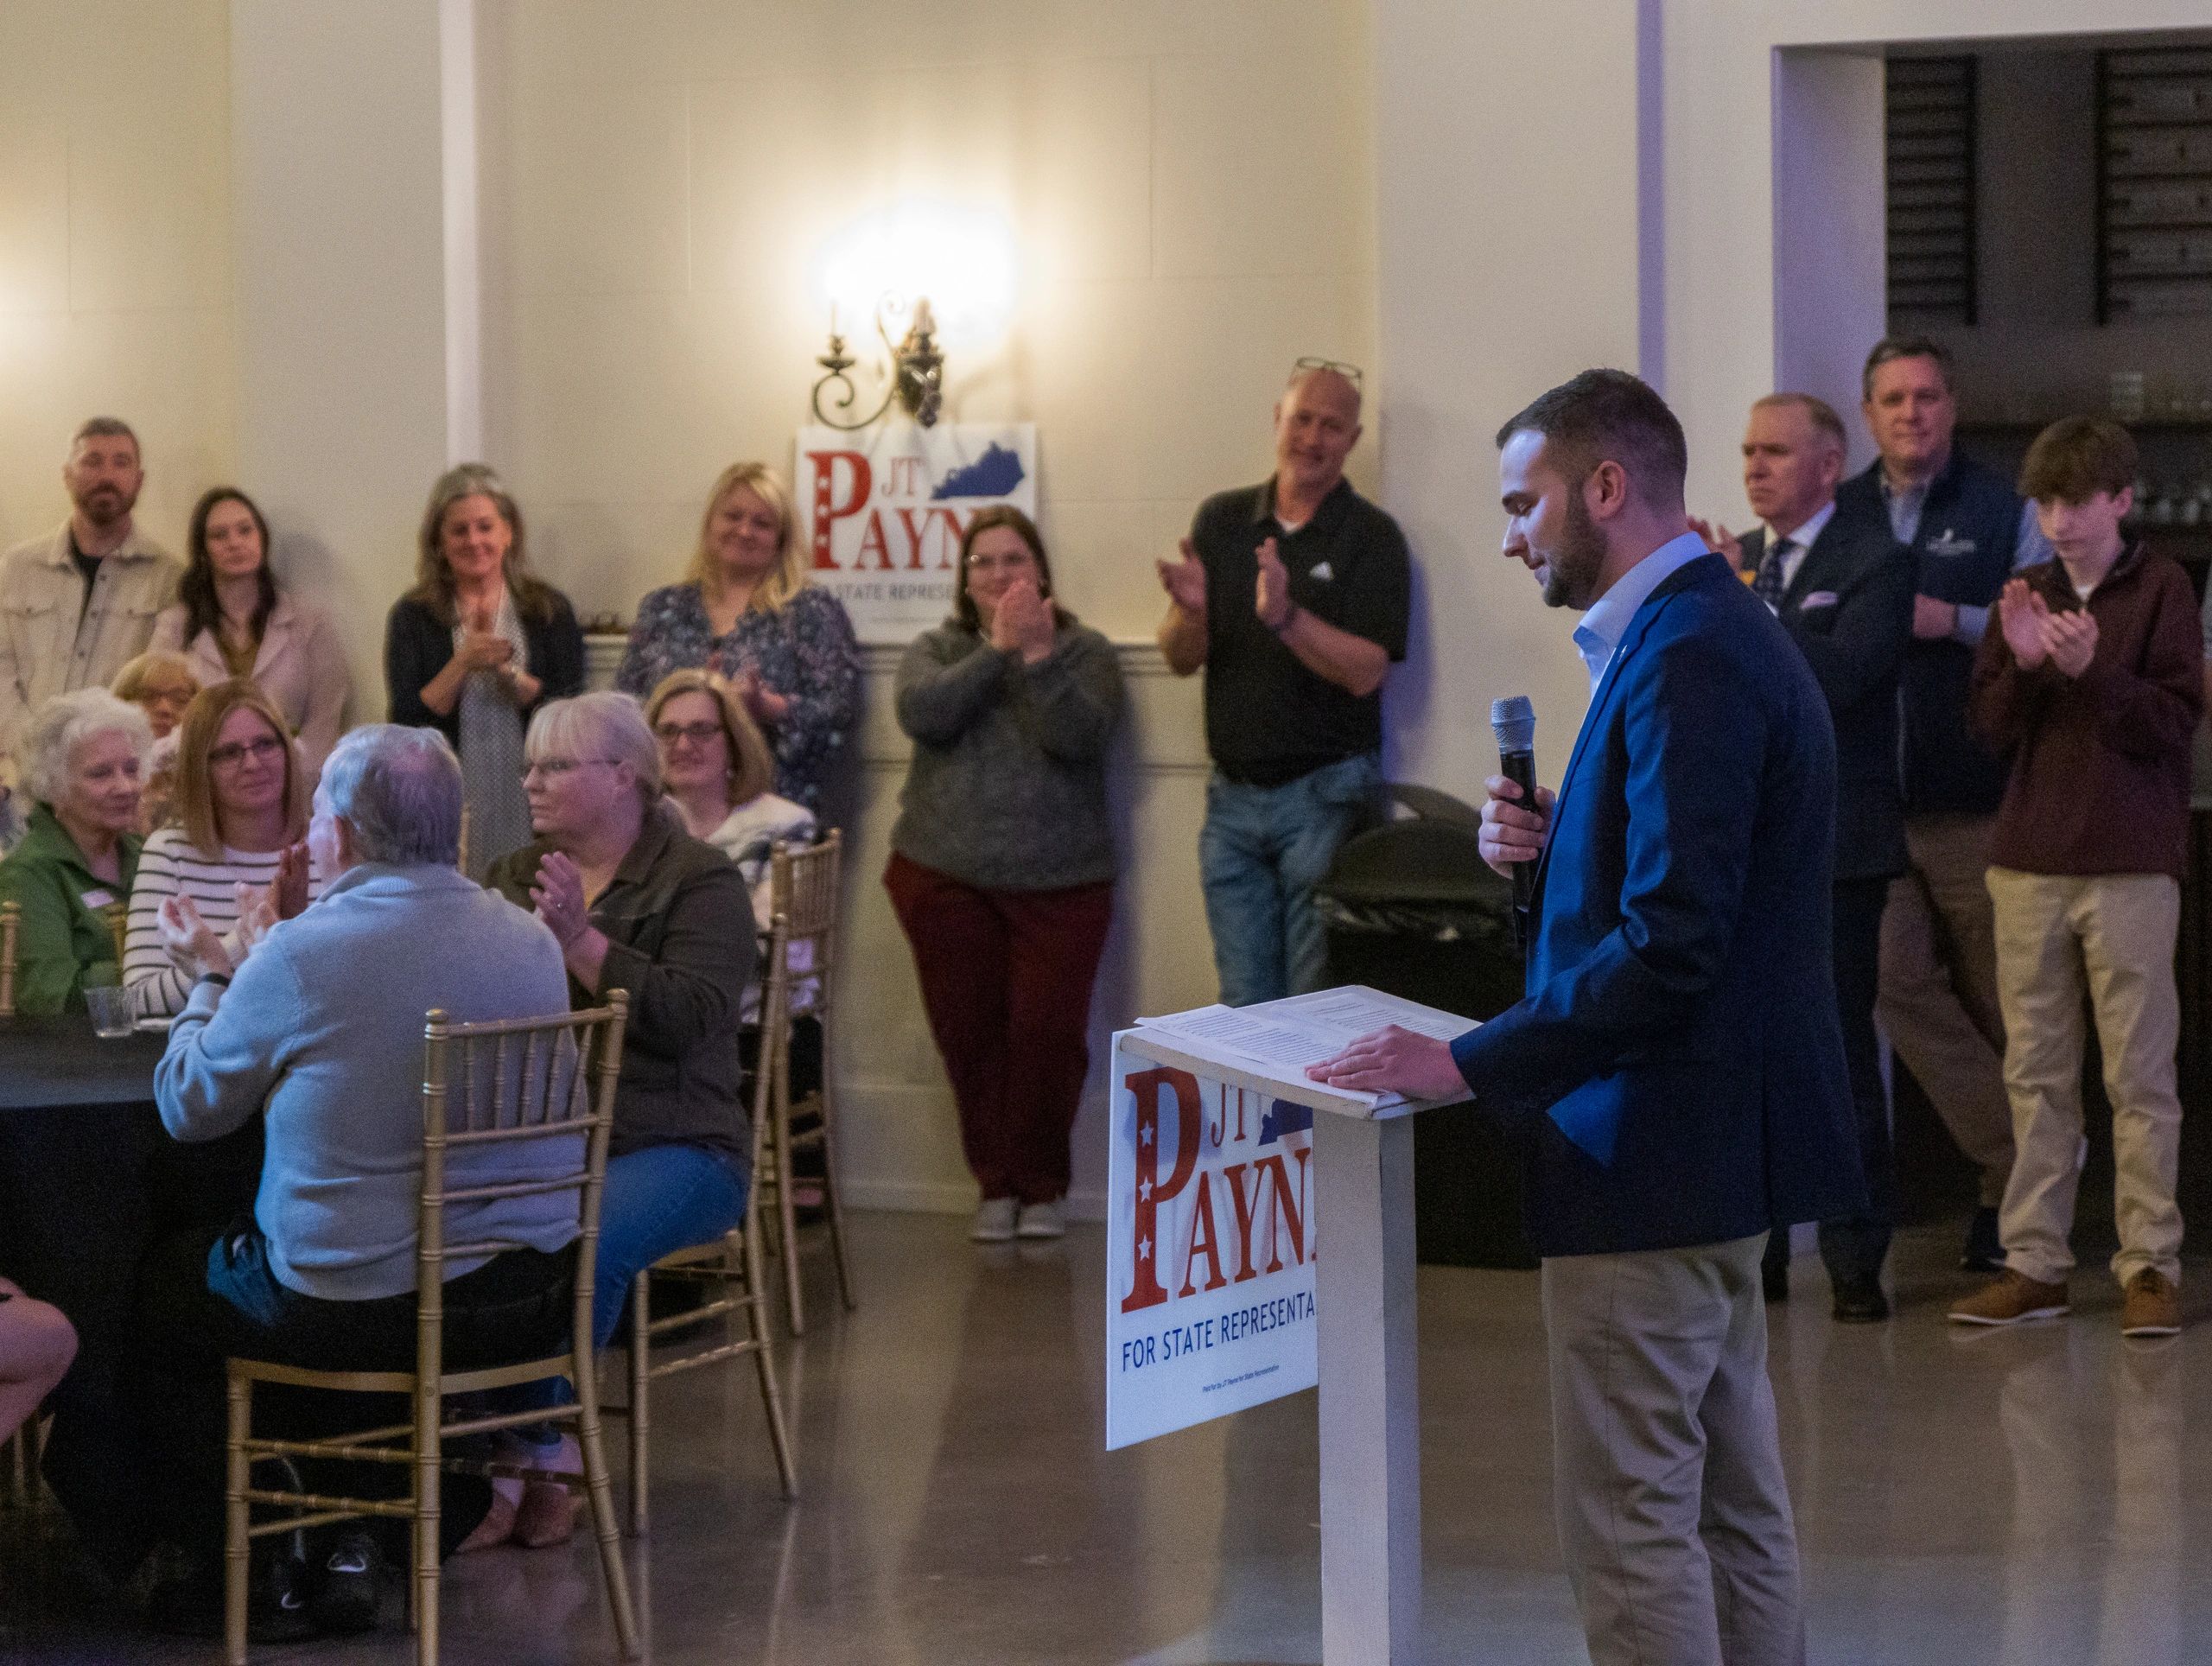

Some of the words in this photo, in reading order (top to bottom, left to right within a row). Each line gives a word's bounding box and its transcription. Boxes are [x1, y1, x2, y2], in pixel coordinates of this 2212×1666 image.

[881, 456, 924, 498] JT
[1121, 1065, 1316, 1314] PAYN
[1122, 1336, 1155, 1372] FOR
[1163, 1319, 1213, 1360] STATE
[1221, 1290, 1315, 1344] REPRESENTA
